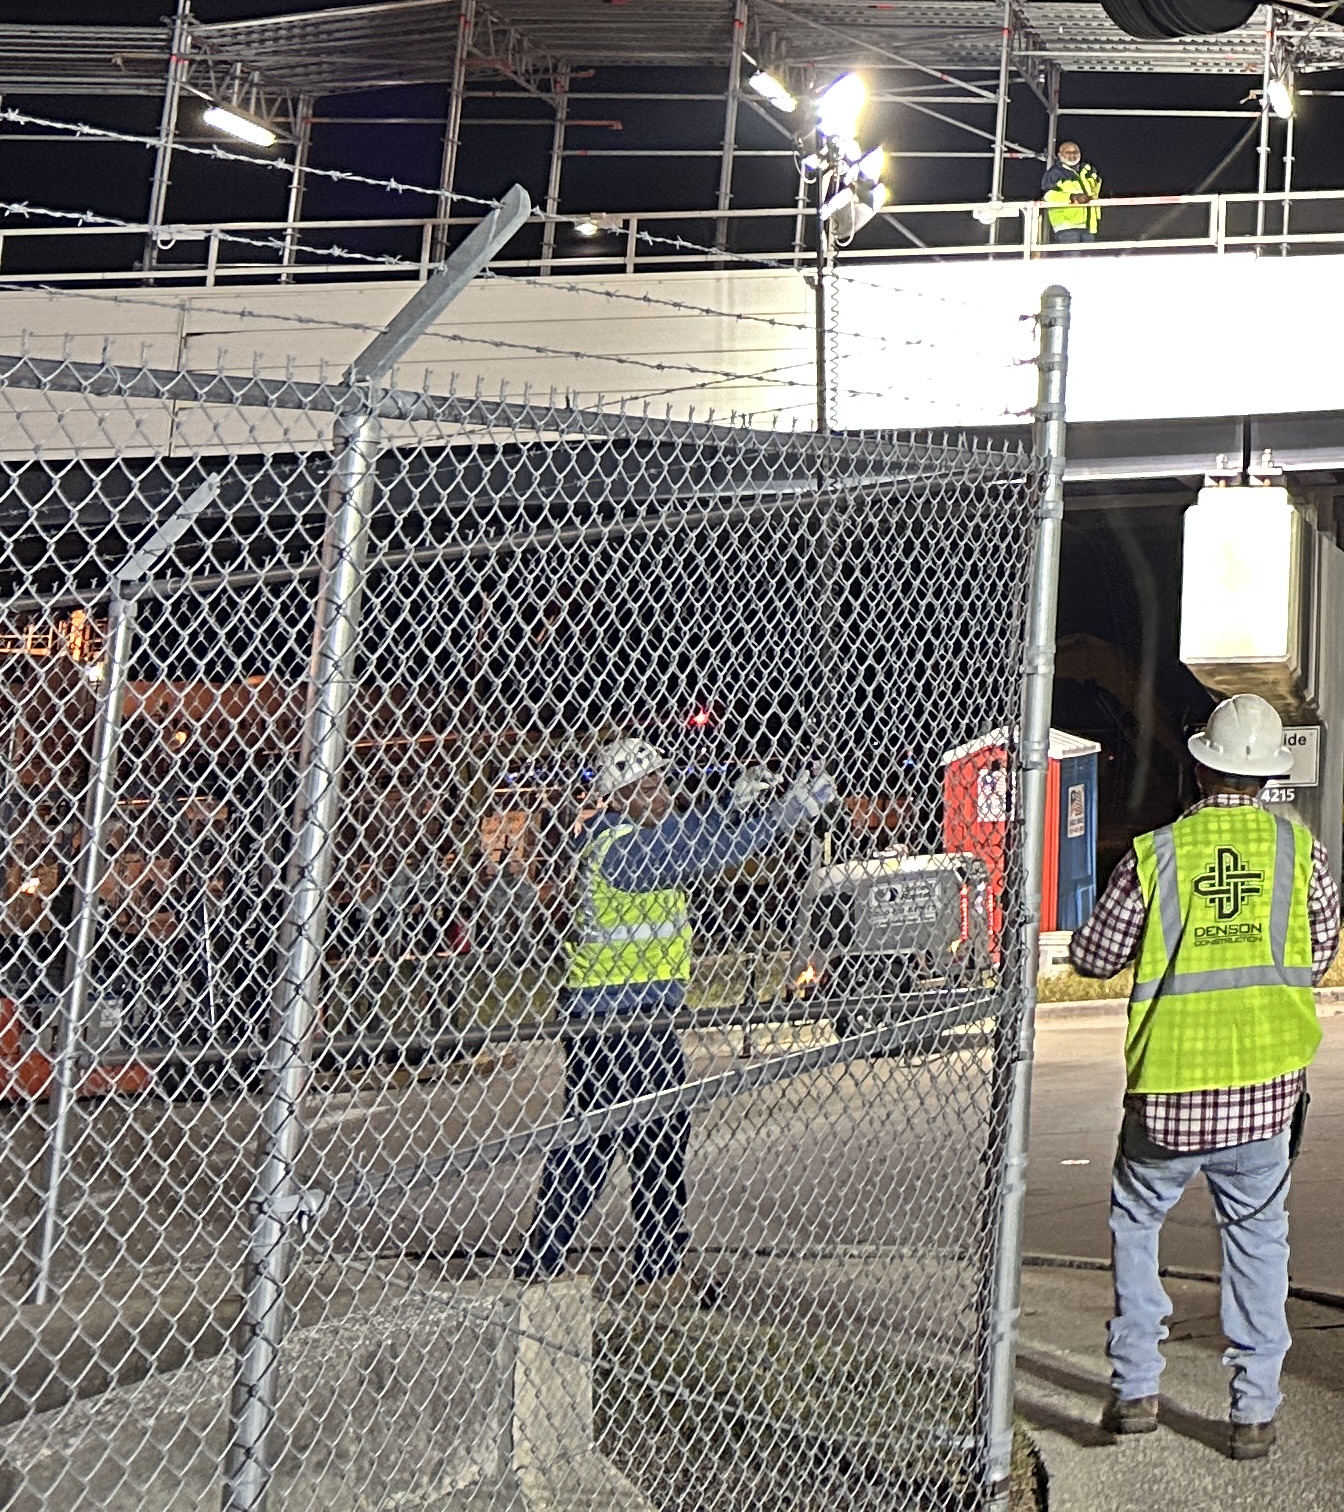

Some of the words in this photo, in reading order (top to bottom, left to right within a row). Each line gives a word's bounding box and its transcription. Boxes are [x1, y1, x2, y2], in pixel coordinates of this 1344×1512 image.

[1283, 733, 1307, 746] ide
[1260, 789, 1295, 803] 4215
[1194, 922, 1262, 938] DENSON
